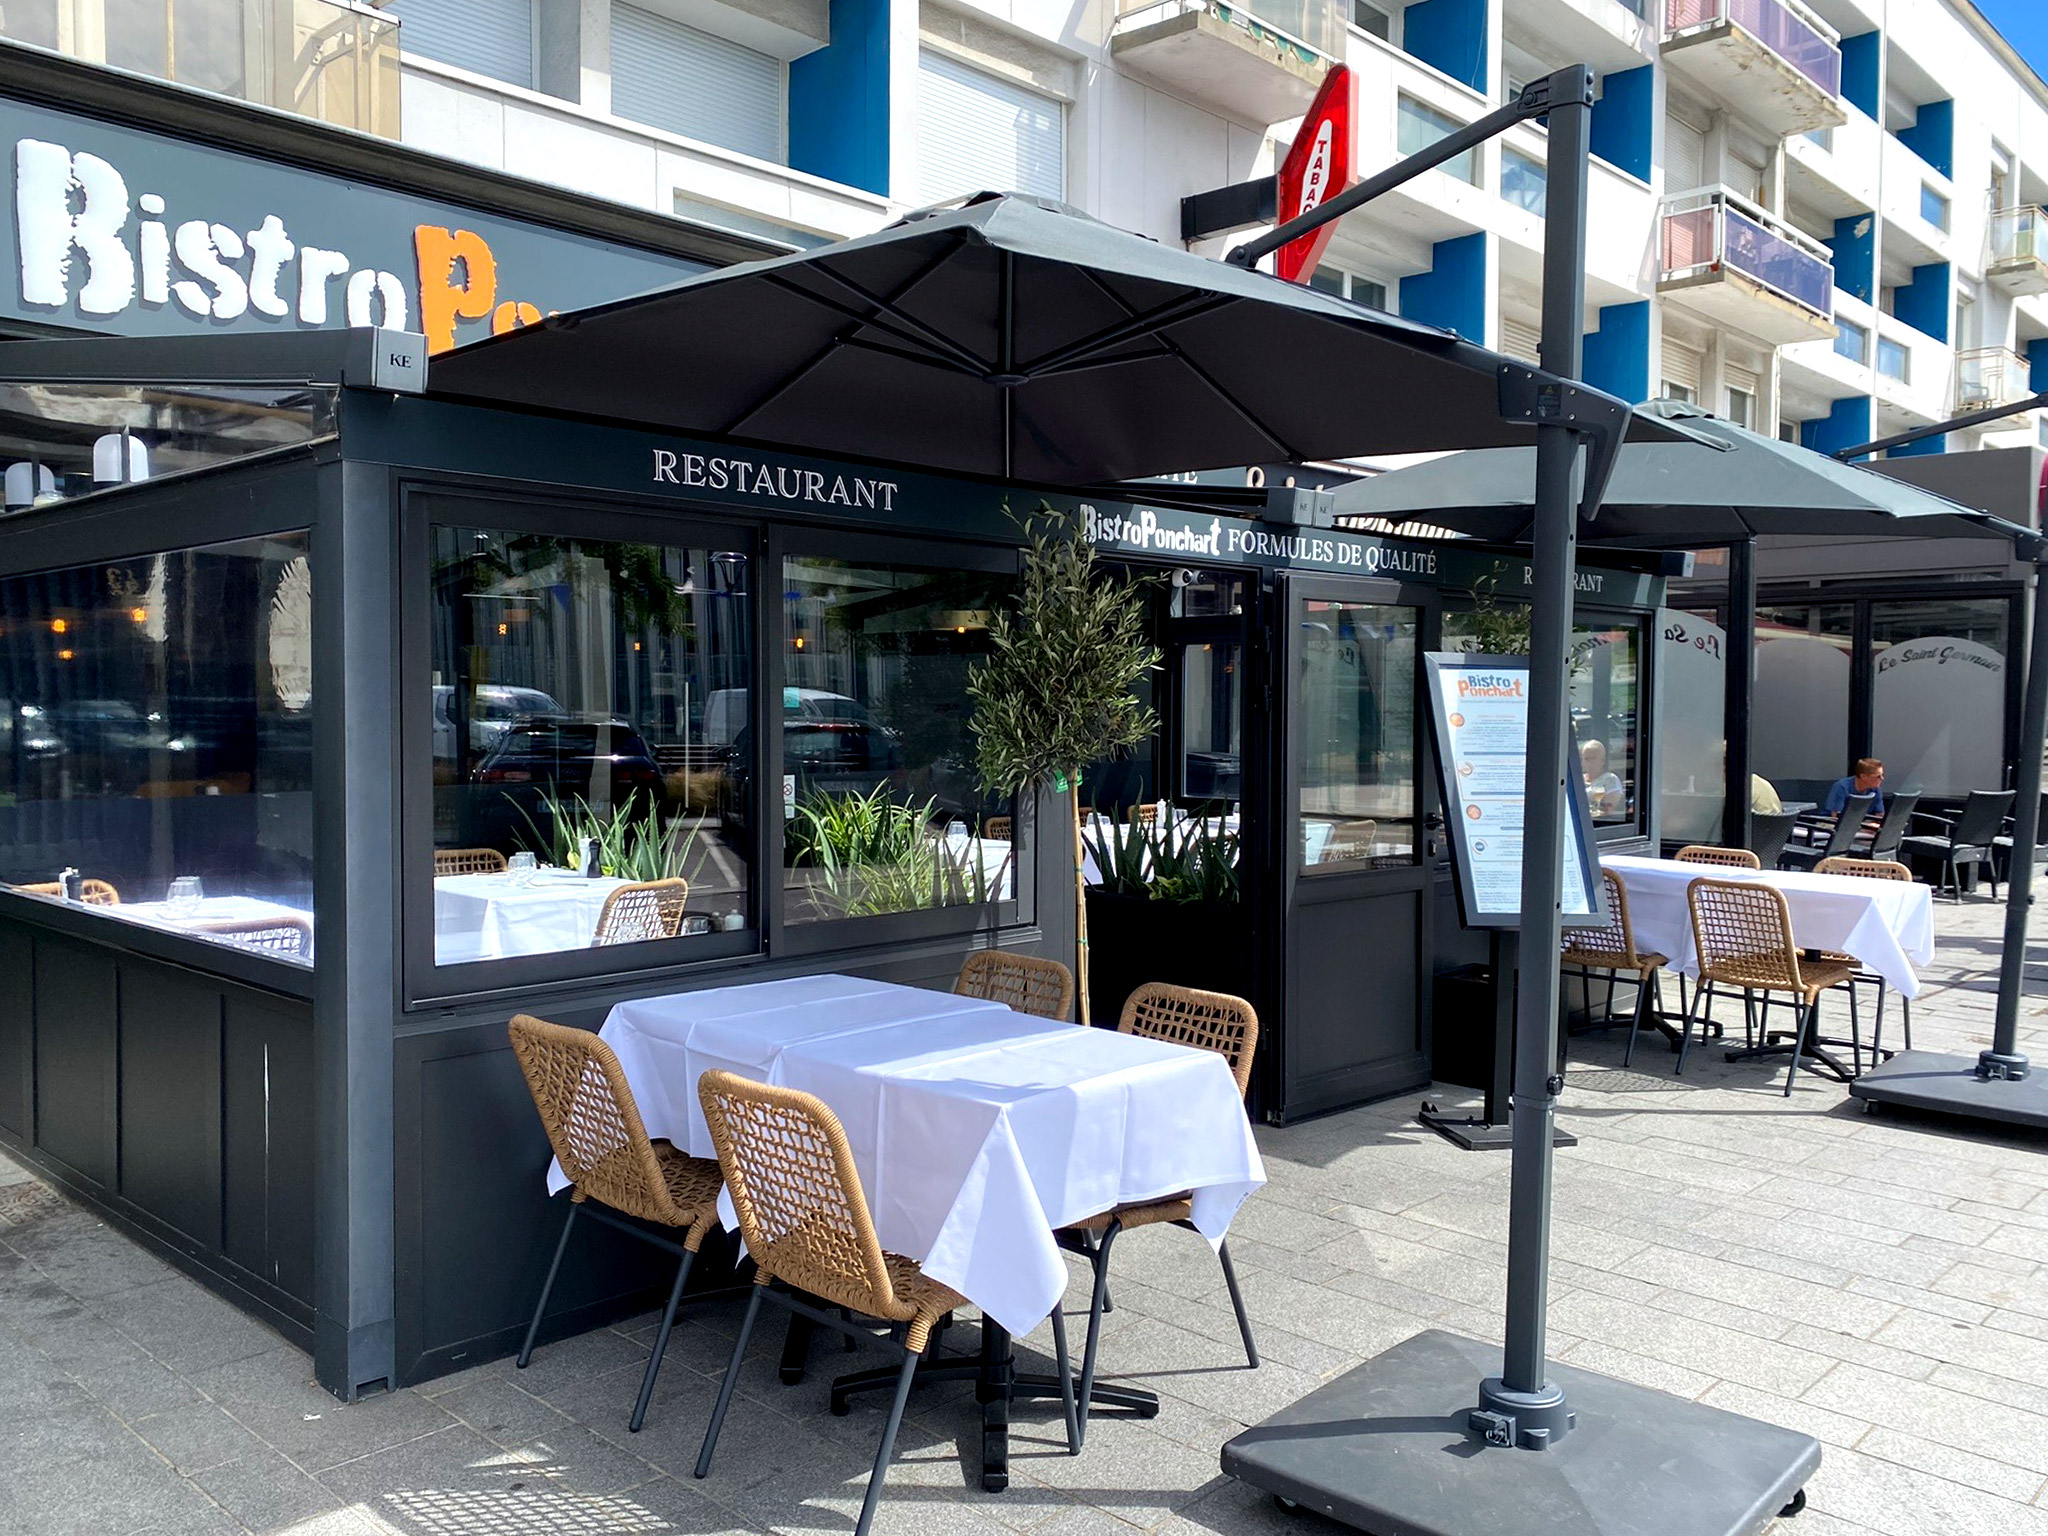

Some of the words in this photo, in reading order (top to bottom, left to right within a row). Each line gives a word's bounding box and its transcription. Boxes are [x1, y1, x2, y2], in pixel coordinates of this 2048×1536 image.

[390, 353, 412, 368] KE
[652, 449, 898, 511] RESTAURANT
[1228, 528, 1334, 563] FORMULES
[1336, 542, 1362, 566] DE
[1366, 546, 1437, 574] QUALITÉ
[1901, 647, 1939, 662] Saint
[1939, 646, 2001, 672] Germain
[1467, 674, 1511, 687] Bistro
